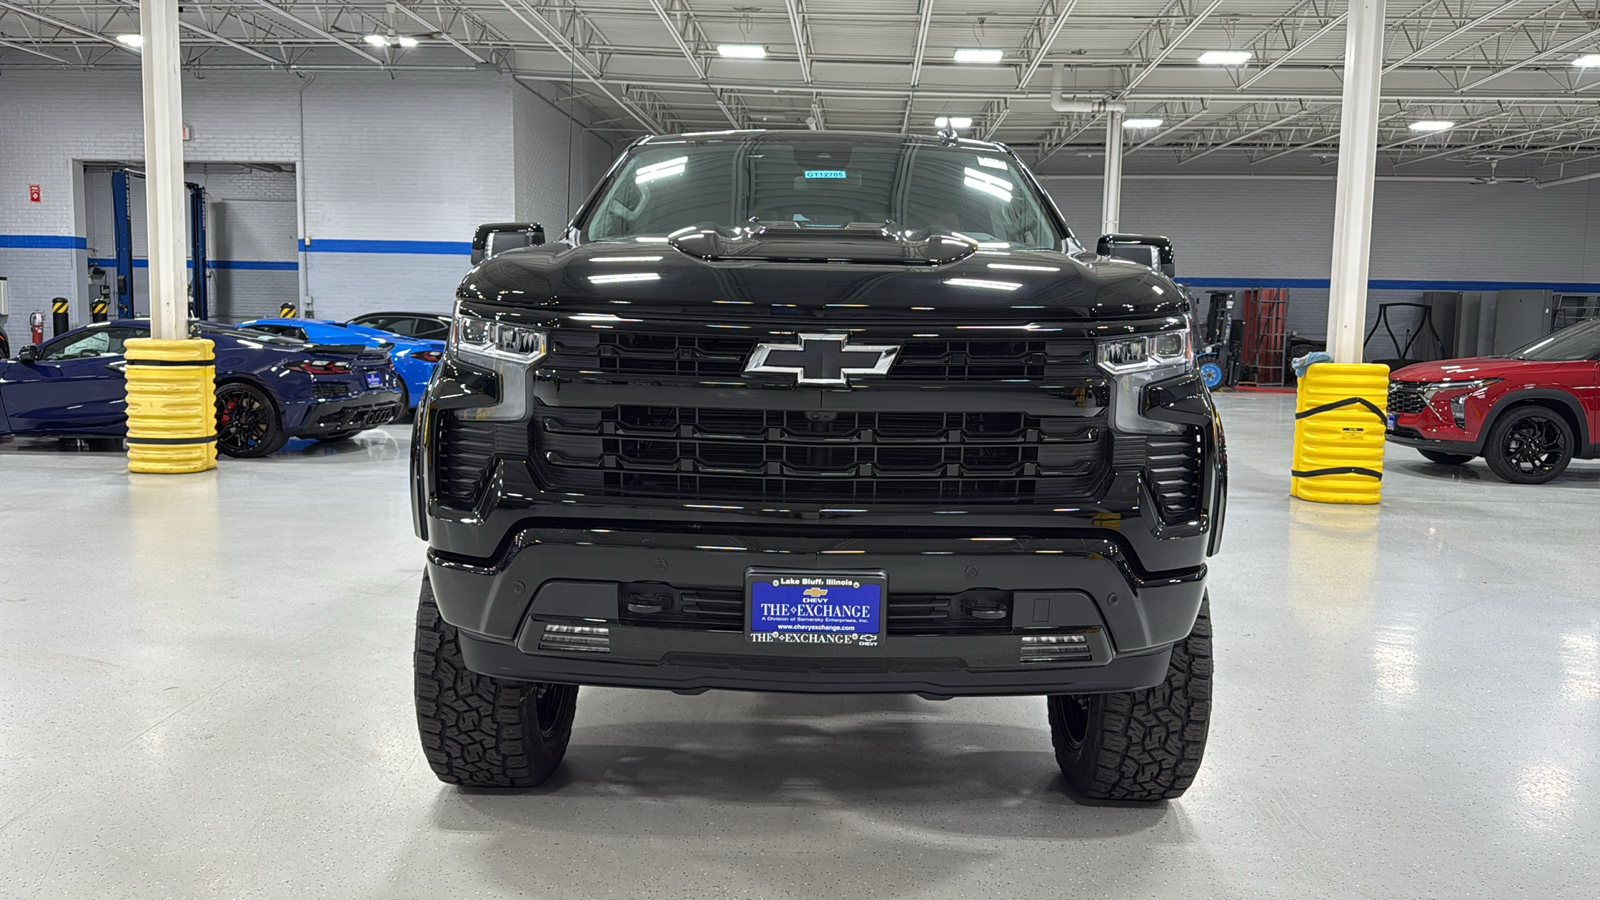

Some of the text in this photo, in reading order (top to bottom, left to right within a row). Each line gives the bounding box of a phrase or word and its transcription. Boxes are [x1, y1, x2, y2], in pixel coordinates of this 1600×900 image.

[826, 578, 853, 586] Illinois
[760, 603, 870, 618] THE EXCHANGE
[778, 624, 855, 632] www.chevyexchange.com
[750, 633, 853, 644] THE EXCHANGE
